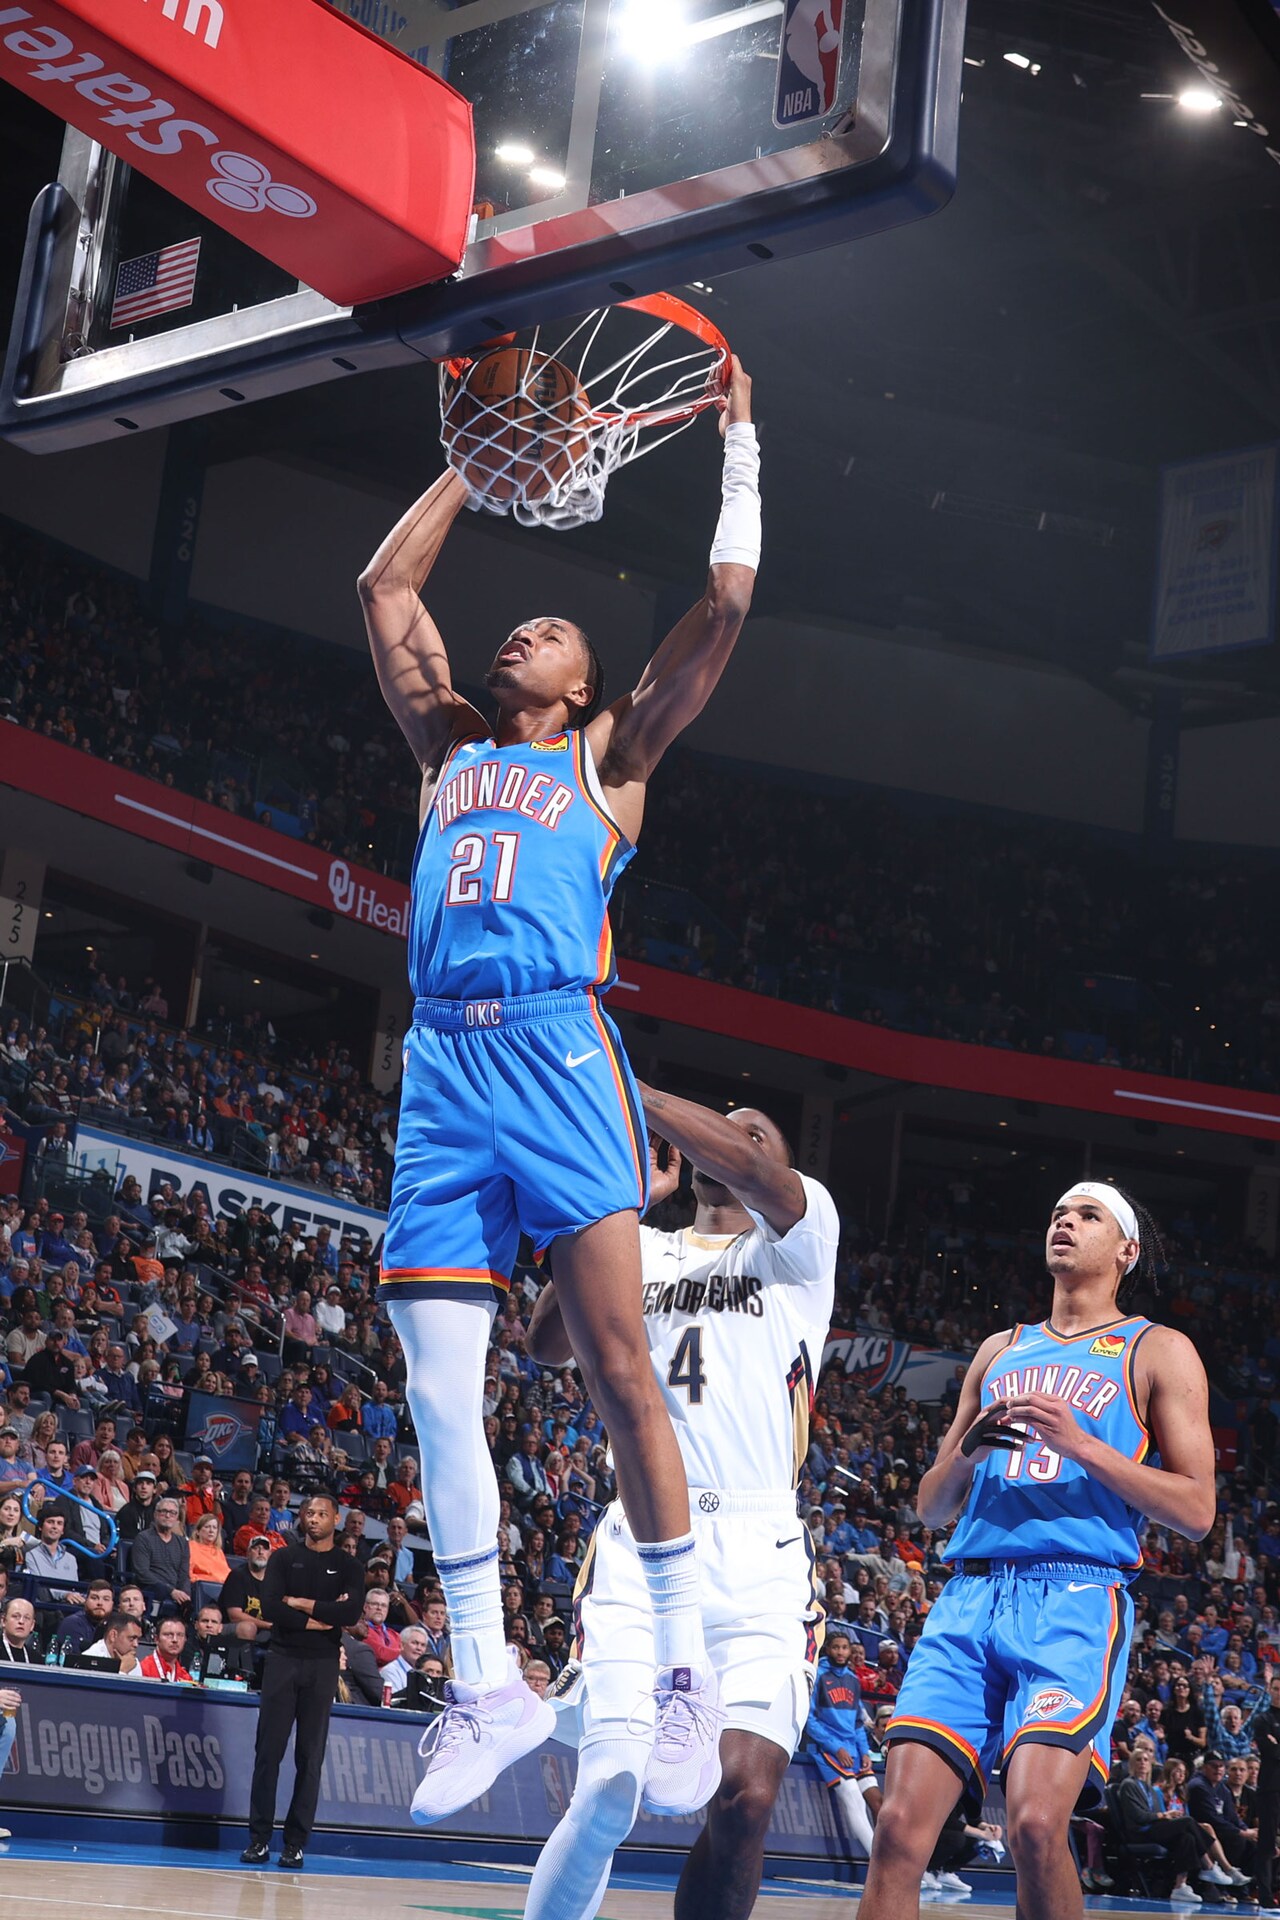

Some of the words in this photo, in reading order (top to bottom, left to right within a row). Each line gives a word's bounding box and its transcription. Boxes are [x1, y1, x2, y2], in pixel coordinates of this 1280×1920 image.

[783, 88, 812, 118] NBA
[526, 363, 559, 459] Wiln
[177, 496, 197, 562] 326
[434, 761, 575, 836] THUNDER
[1159, 752, 1174, 810] 328
[328, 860, 356, 912] OU
[355, 885, 410, 936] Heal
[445, 831, 521, 907] 21
[9, 880, 27, 944] 225
[381, 1014, 396, 1071] 225
[464, 1002, 502, 1027] OKC
[643, 1281, 676, 1316] EW
[673, 1275, 764, 1318] OREANS
[667, 1326, 708, 1405] 4
[820, 1336, 889, 1374] OKC
[988, 1364, 1121, 1421] THUNDER
[203, 1422, 235, 1443] OKC
[1005, 1422, 1062, 1482] 13
[1029, 1696, 1064, 1714] OKC
[21, 1702, 143, 1794] League
[143, 1714, 225, 1790] Pass
